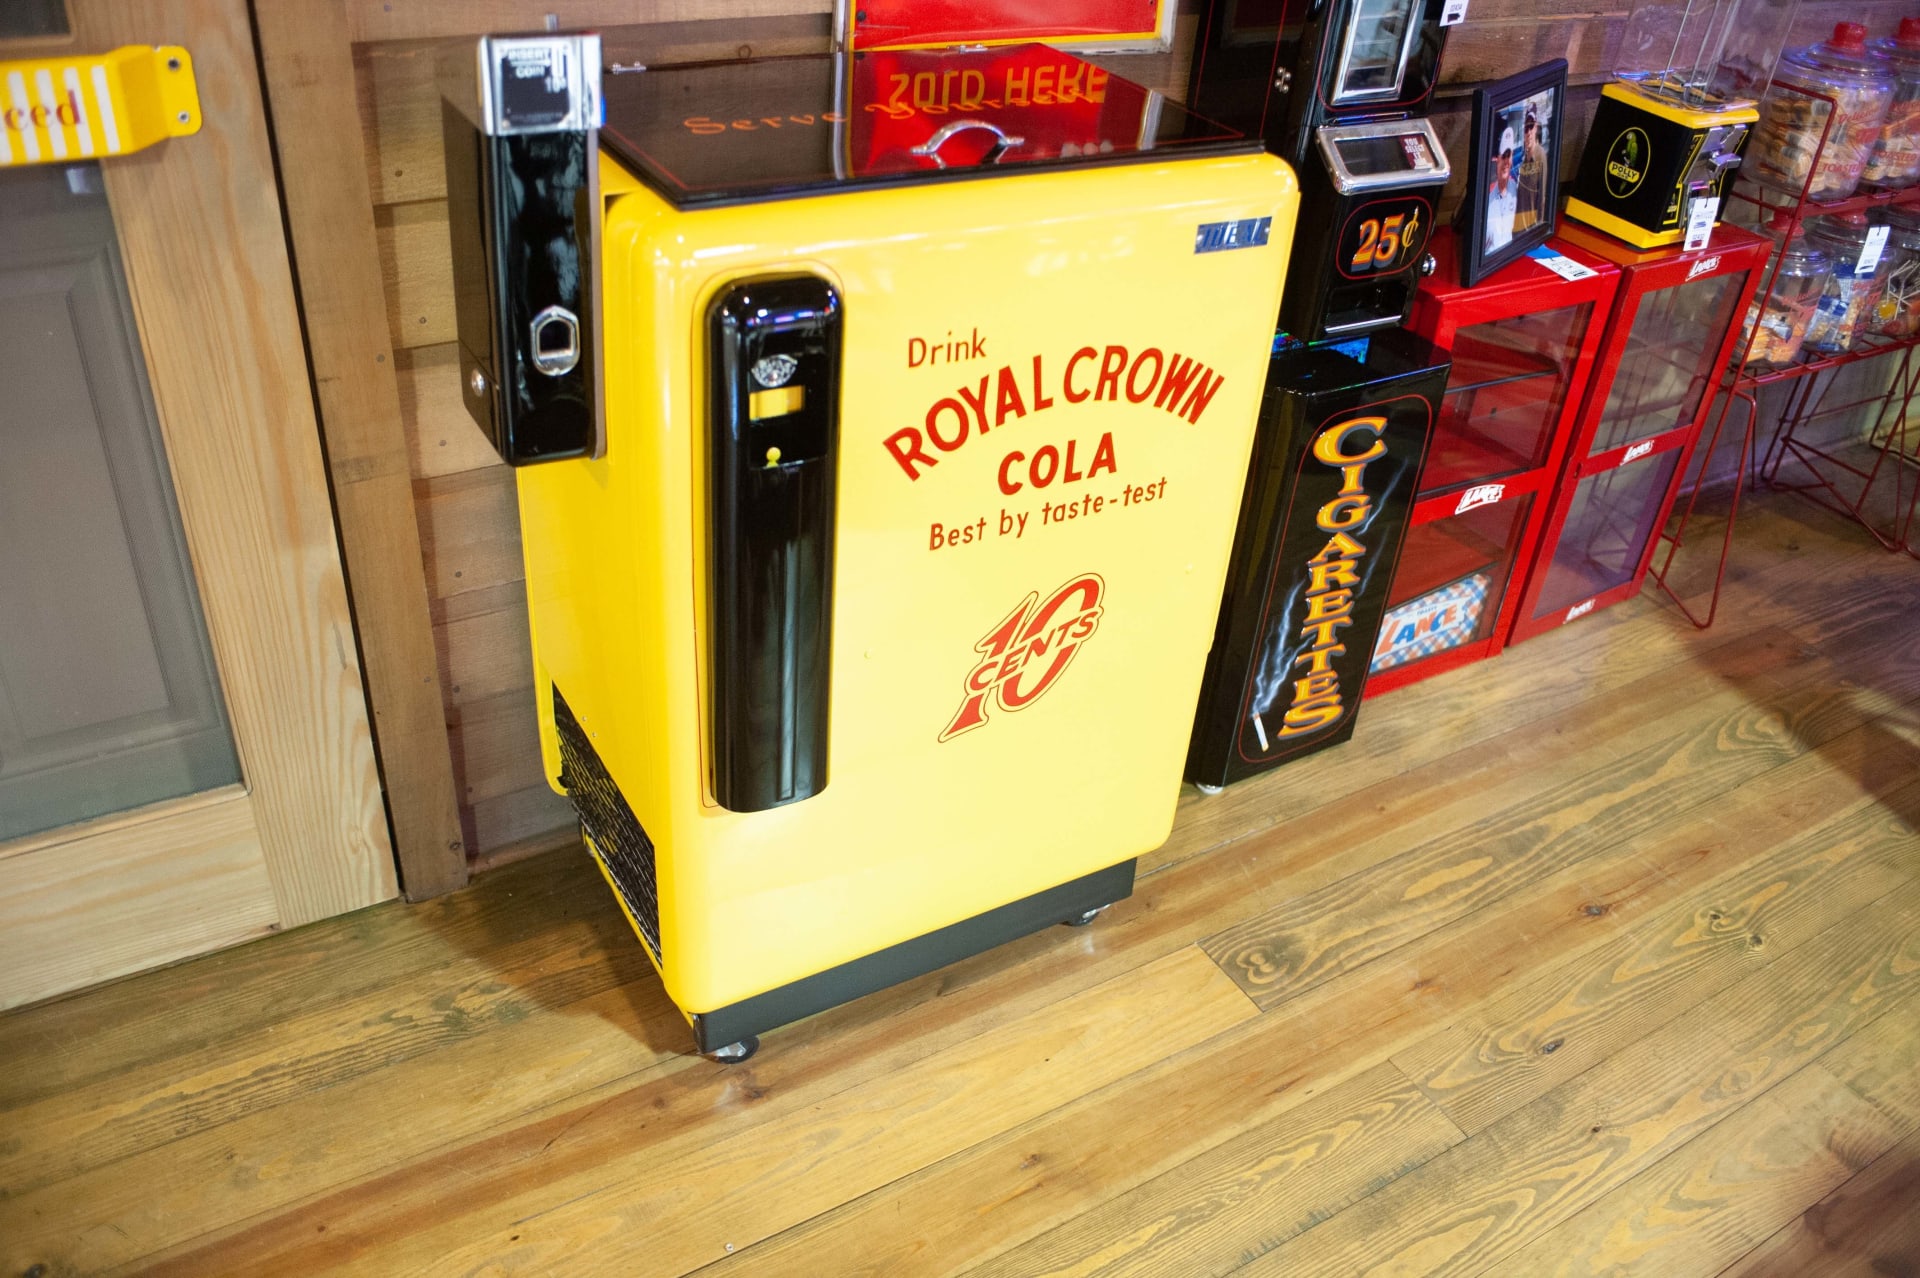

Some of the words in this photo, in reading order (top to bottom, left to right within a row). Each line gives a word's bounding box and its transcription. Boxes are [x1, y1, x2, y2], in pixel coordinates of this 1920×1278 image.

[515, 66, 546, 78] COIN
[683, 112, 847, 136] Serve
[1611, 163, 1638, 180] POLLY
[1350, 205, 1419, 272] 25¢
[907, 328, 987, 369] Drink
[882, 354, 1054, 482] ROYAL
[1063, 345, 1226, 426] CROWN
[998, 431, 1118, 495] COLA
[929, 517, 987, 551] Best
[999, 509, 1029, 539] by
[1041, 476, 1168, 526] taste-test
[1277, 416, 1388, 740] CIGARETTES
[944, 578, 1100, 737] 10
[969, 611, 1099, 691] CENTS
[1375, 604, 1458, 657] LANCE
